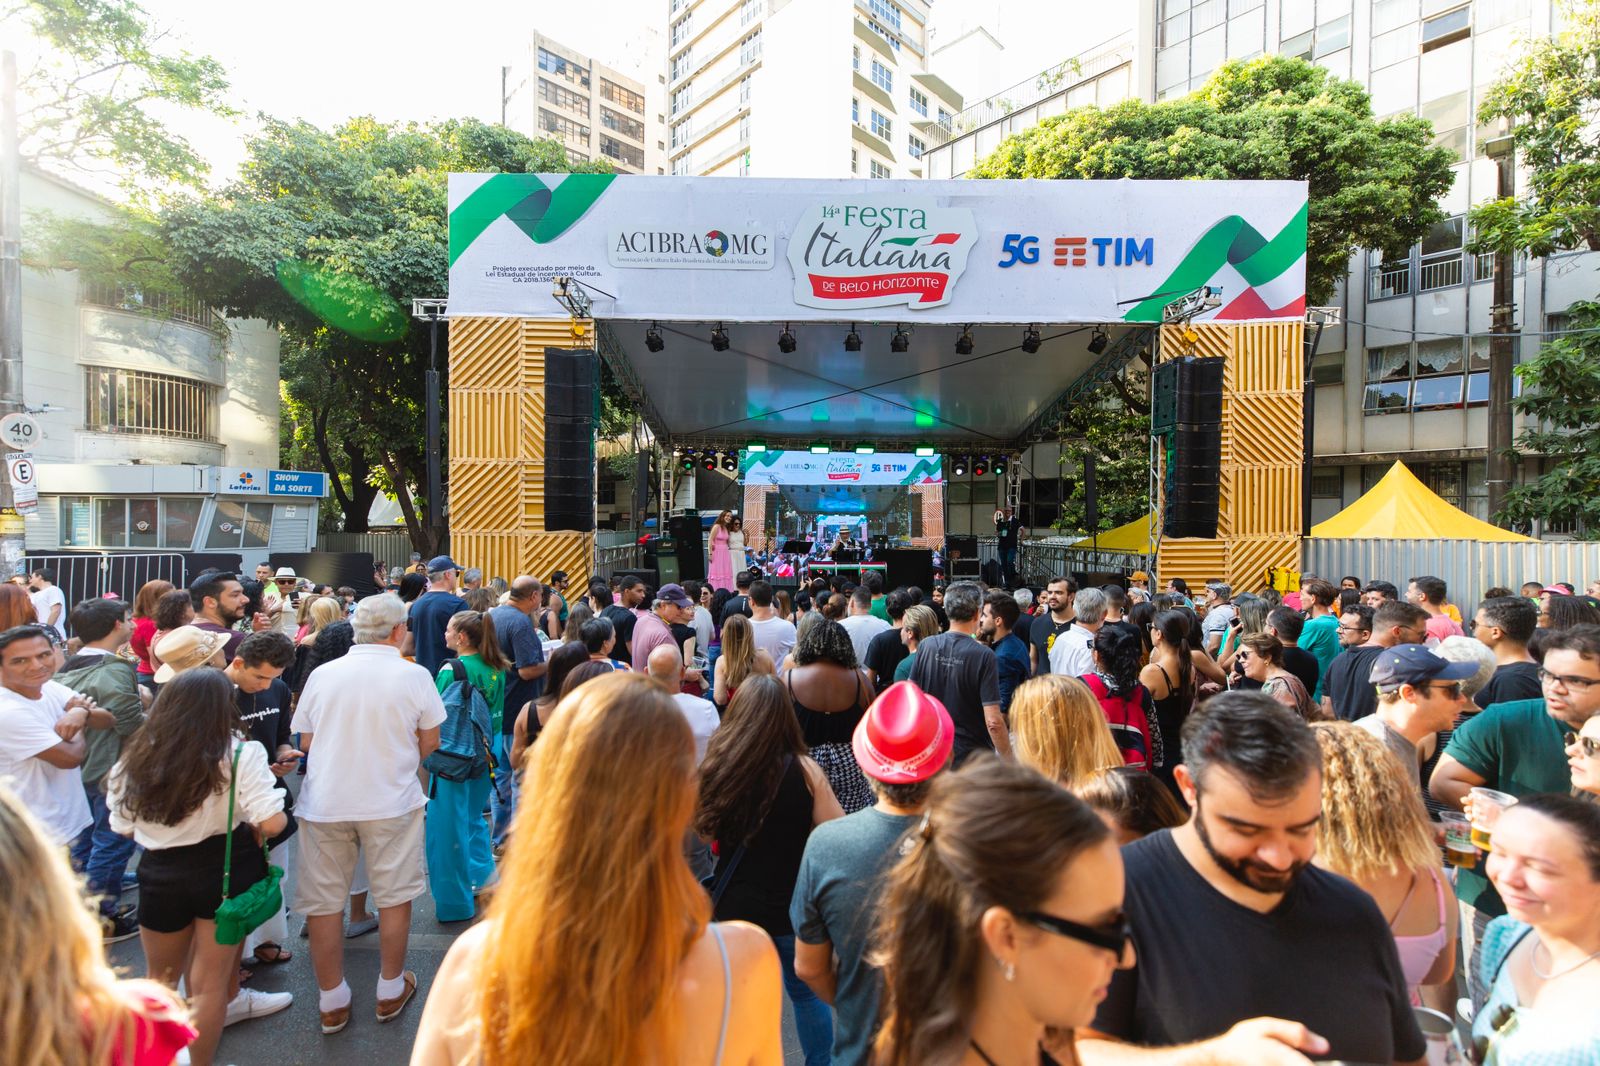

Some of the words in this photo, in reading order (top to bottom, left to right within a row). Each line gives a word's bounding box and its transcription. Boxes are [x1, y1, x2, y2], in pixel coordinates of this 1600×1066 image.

[616, 231, 703, 254] ACIBRA
[731, 233, 768, 256] MG
[804, 221, 951, 270] Italiana
[997, 233, 1039, 268] 5G
[1092, 237, 1154, 267] TIM
[9, 422, 33, 437] 40
[19, 464, 29, 480] E
[871, 463, 881, 473] 5G
[892, 464, 907, 473] TIM
[274, 473, 300, 482] SHOW
[274, 484, 286, 492] DA
[288, 484, 313, 493] SORTE
